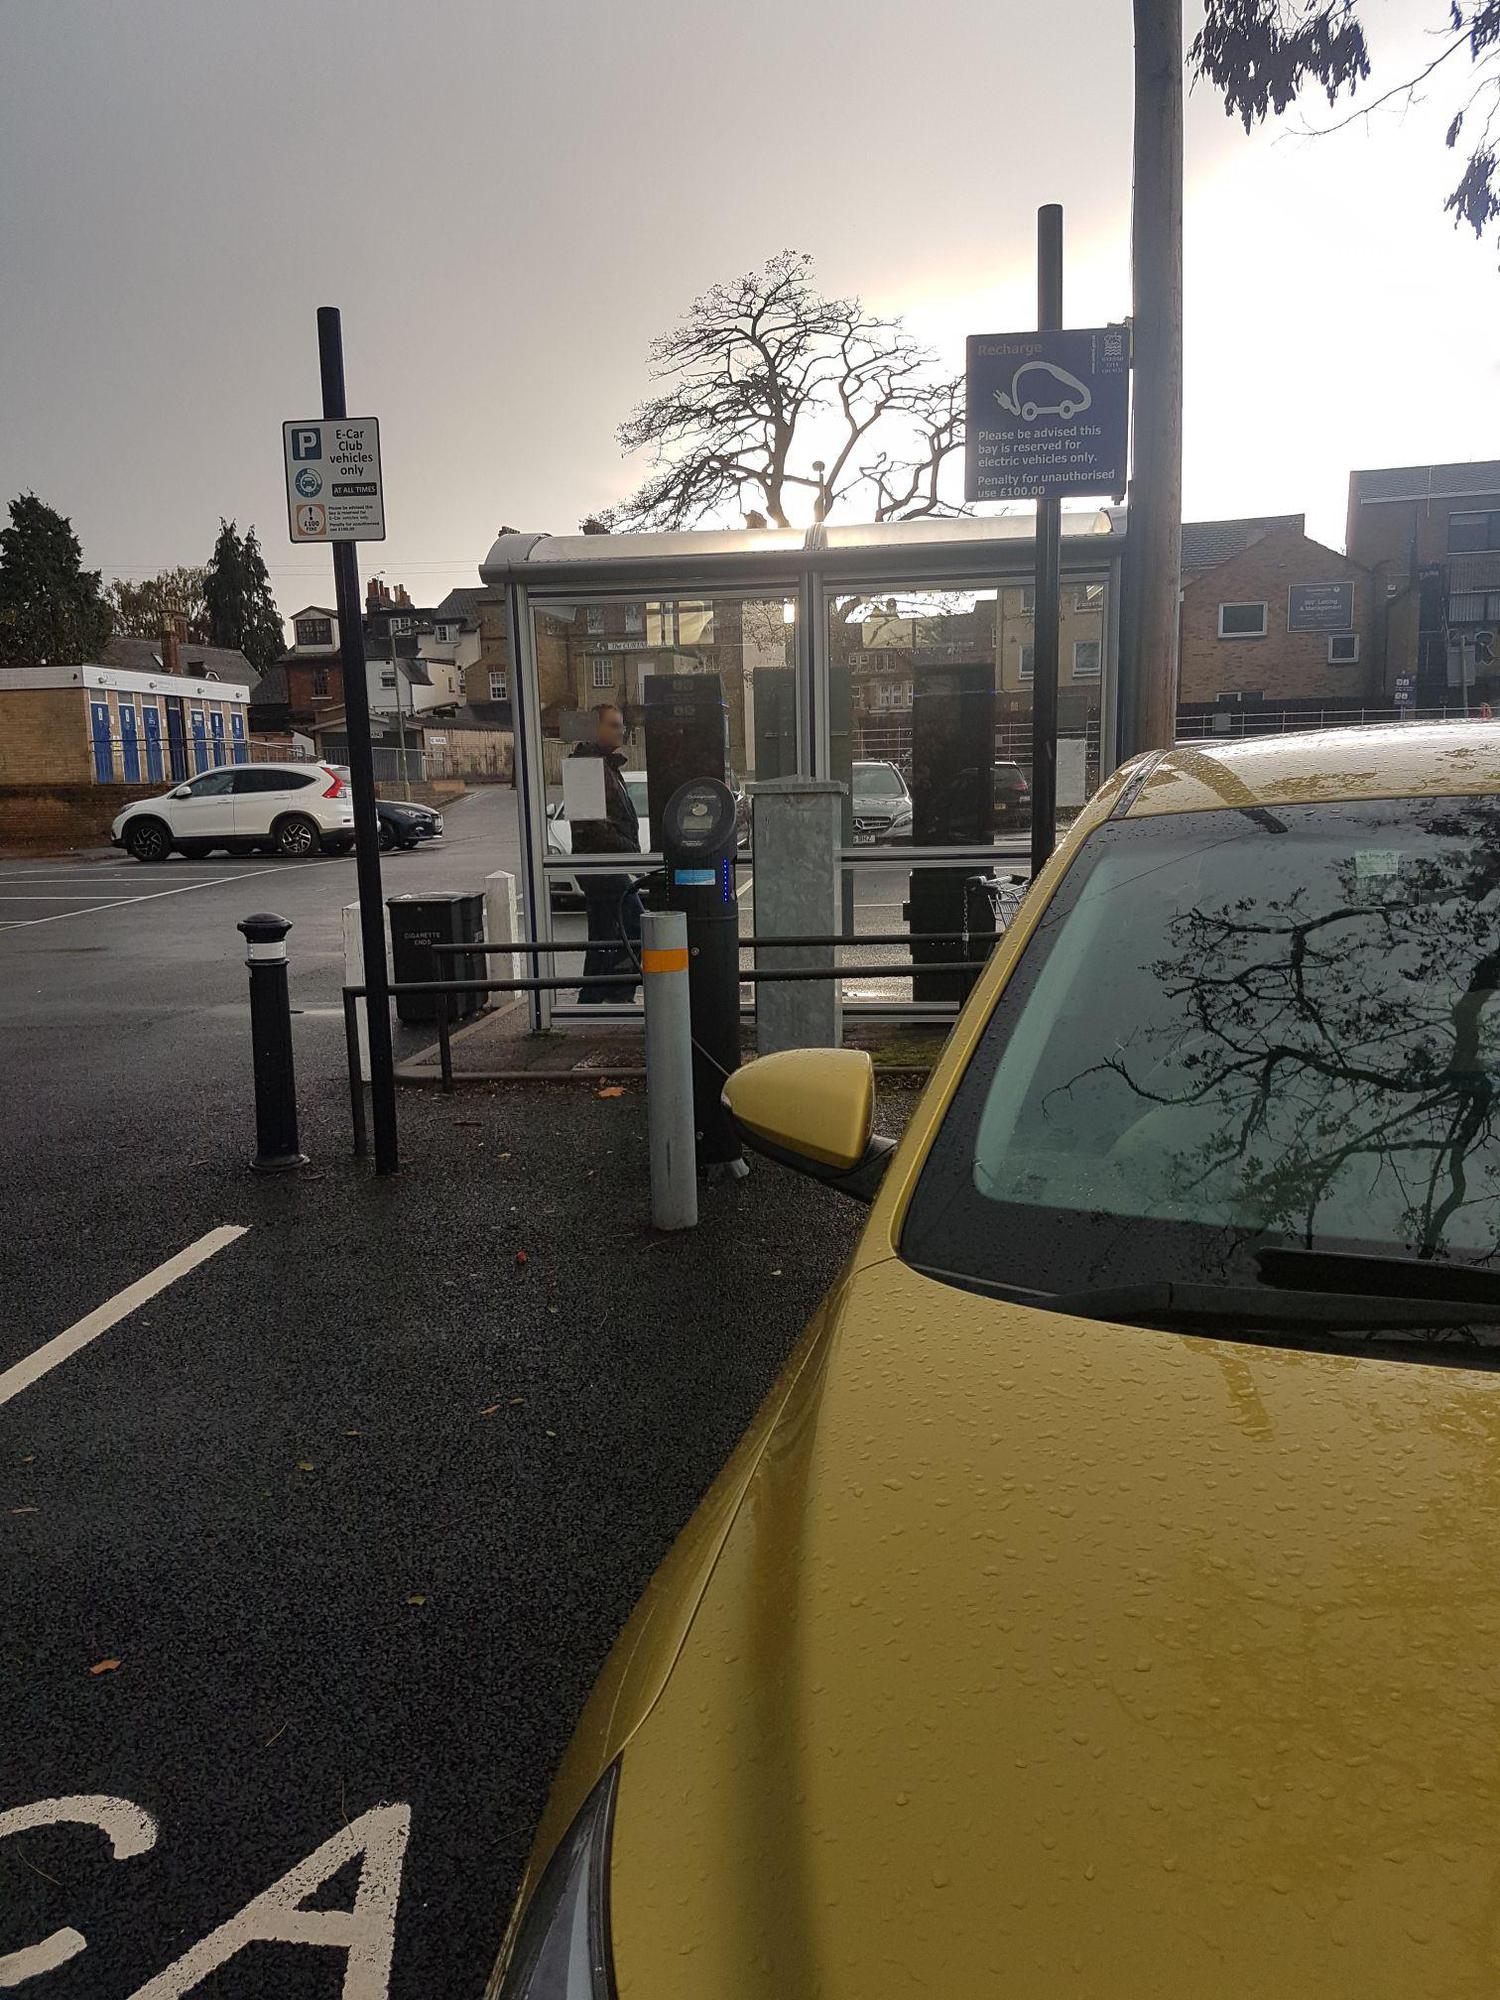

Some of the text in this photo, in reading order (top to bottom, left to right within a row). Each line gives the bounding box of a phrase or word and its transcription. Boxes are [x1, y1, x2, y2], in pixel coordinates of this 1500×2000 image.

[978, 343, 1042, 357] Recharge
[336, 429, 364, 440] E-Car
[978, 425, 1101, 441] Please be advised this
[338, 441, 363, 451] Club
[978, 439, 1081, 455] bay is reserved for
[329, 452, 374, 463] vehicles
[978, 451, 1098, 468] electric vehicles only.
[340, 464, 364, 476] only
[977, 469, 1115, 487] Penalty for unauthorised
[343, 486, 354, 494] ALL
[355, 484, 376, 493] TIMES
[977, 485, 1046, 498] use £100.00
